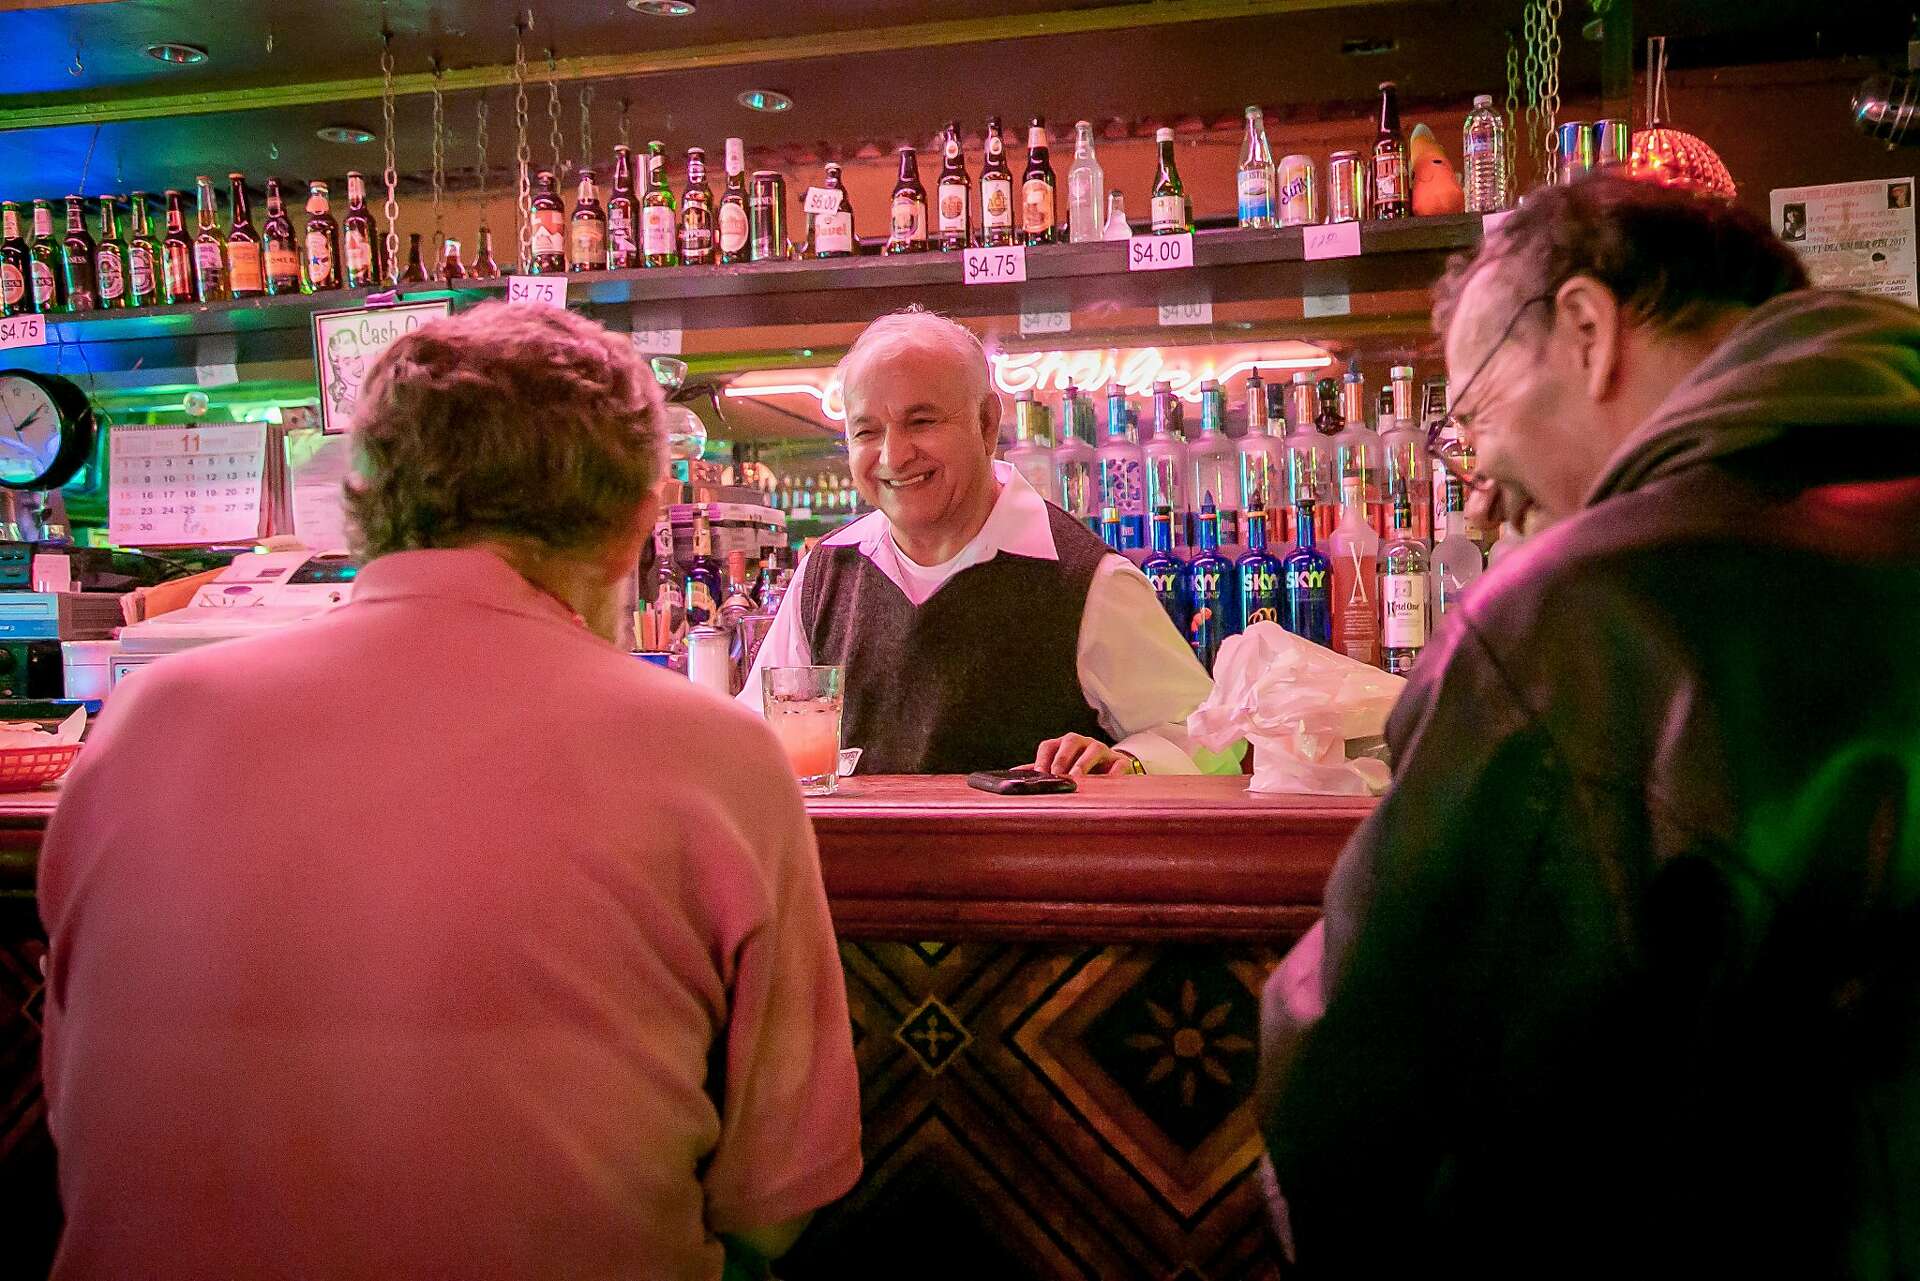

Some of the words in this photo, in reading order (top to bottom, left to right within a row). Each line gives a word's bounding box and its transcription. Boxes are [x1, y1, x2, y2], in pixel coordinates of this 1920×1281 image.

[1132, 240, 1181, 263] $4.00
[968, 254, 1017, 281] $4.75
[0, 320, 39, 342] $4.75
[360, 319, 398, 345] Cash
[181, 434, 200, 452] 11
[1150, 574, 1176, 592] KYY
[1191, 573, 1220, 592] KYY
[1244, 573, 1279, 592] SKYY
[1286, 571, 1326, 589] SKYY
